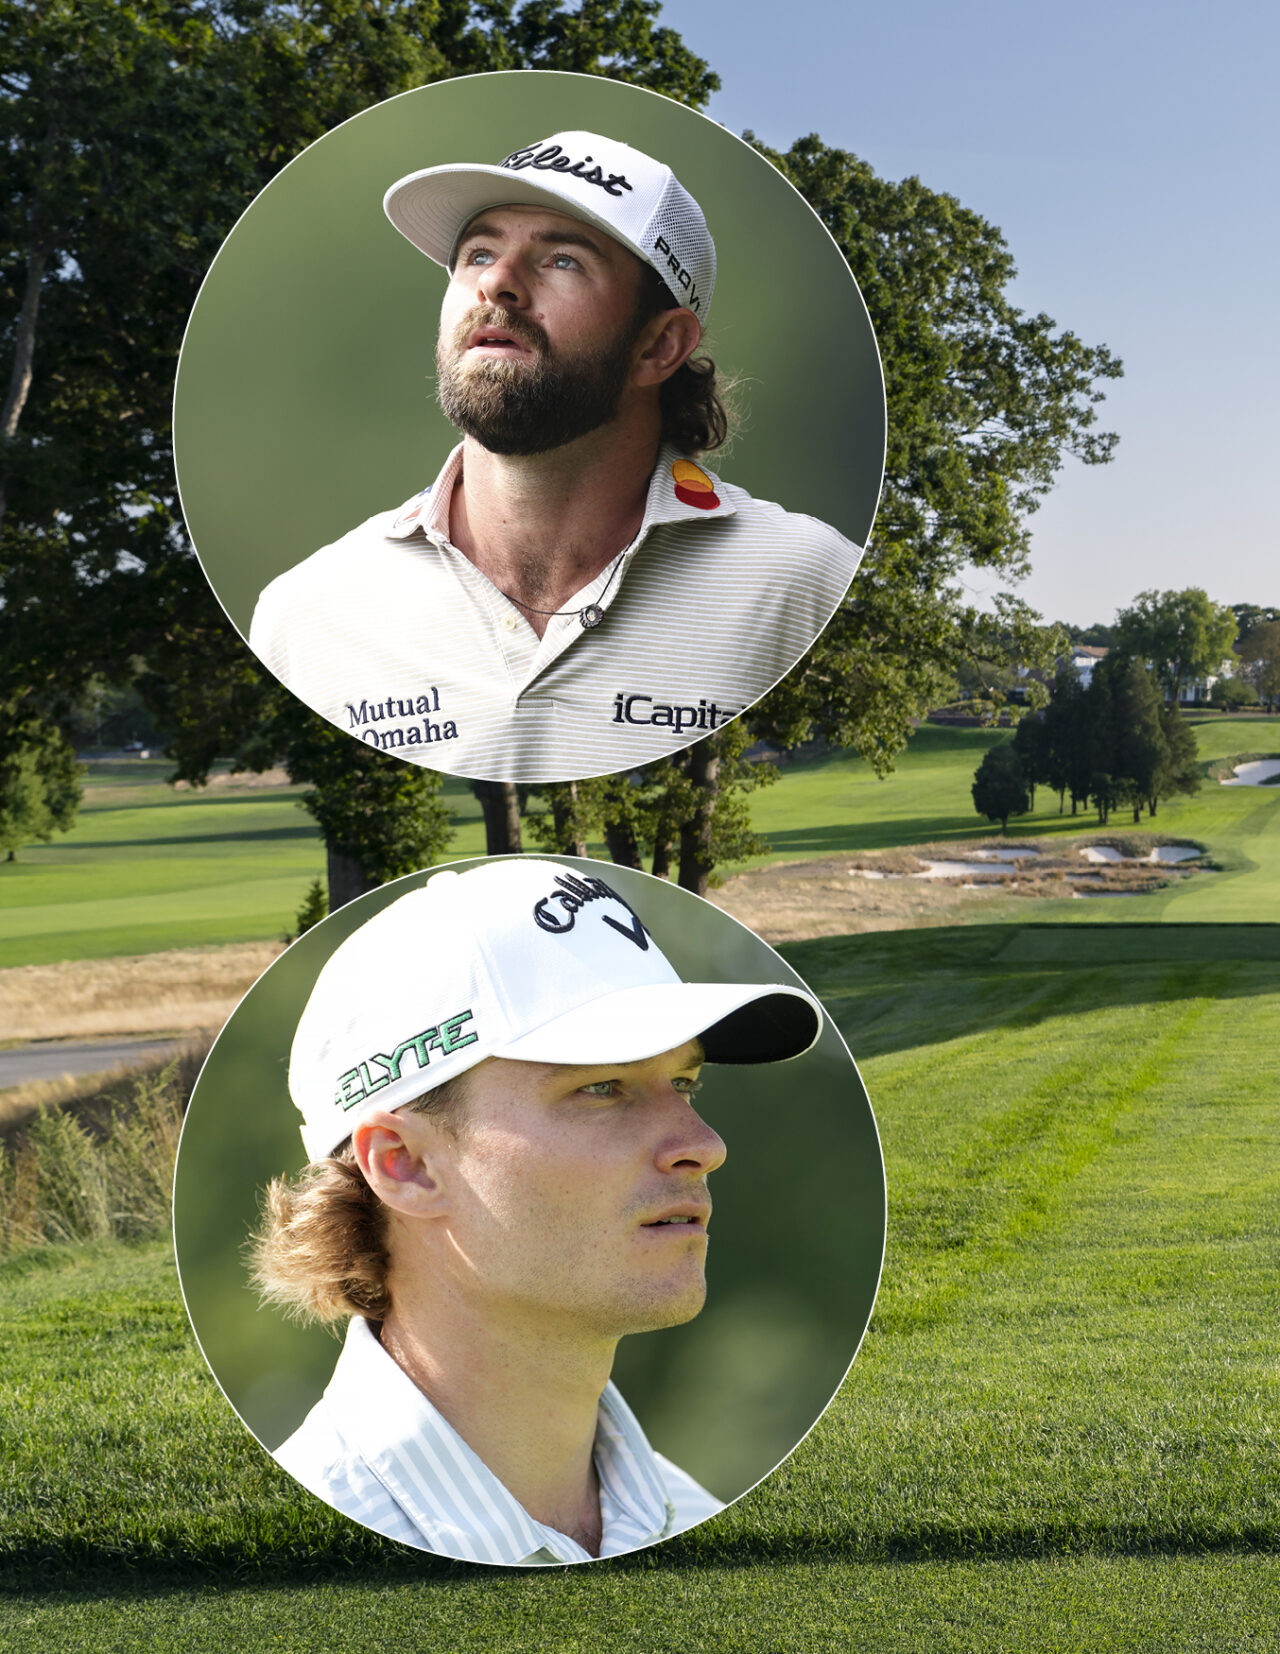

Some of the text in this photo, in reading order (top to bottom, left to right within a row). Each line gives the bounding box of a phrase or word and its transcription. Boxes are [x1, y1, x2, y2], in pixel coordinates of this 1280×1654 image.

[346, 686, 441, 728] Mutual
[612, 693, 745, 733] iCapit
[335, 1009, 478, 1112] ELYTE
